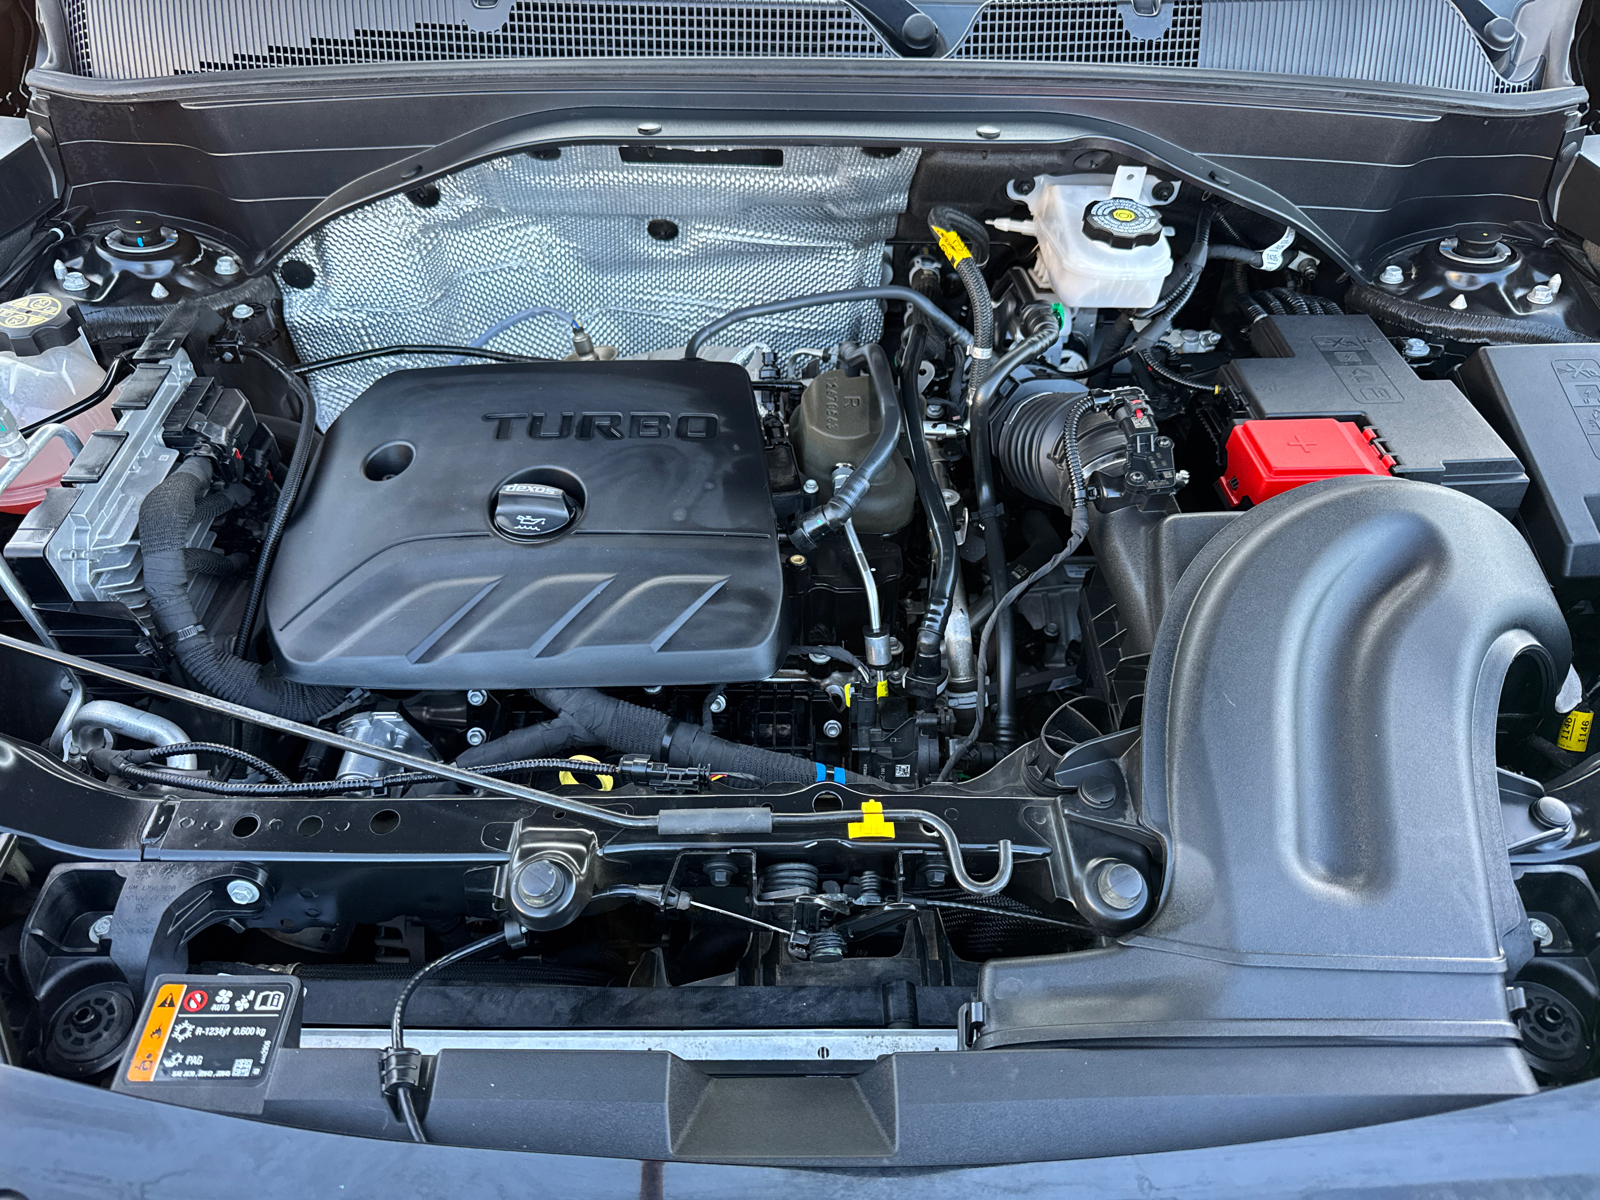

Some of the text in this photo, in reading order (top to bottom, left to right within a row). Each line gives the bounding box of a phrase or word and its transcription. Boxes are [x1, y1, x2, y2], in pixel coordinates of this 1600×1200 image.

[844, 395, 861, 408] R
[483, 411, 719, 440] TURBO
[505, 483, 556, 495] dexos
[1578, 720, 1590, 743] 1146
[210, 1003, 230, 1012] AUTO
[195, 1026, 267, 1037] R-1234yf 0.600 kg
[185, 1055, 204, 1066] PAG
